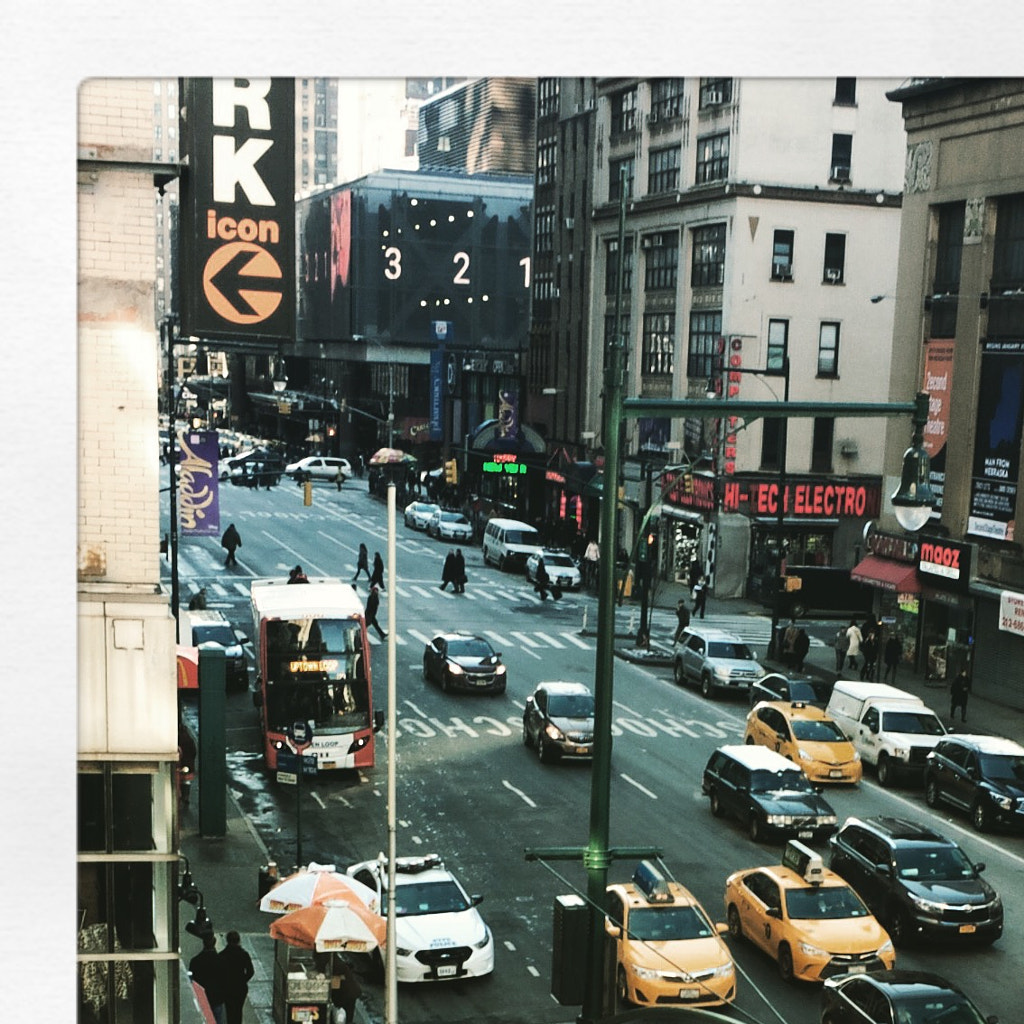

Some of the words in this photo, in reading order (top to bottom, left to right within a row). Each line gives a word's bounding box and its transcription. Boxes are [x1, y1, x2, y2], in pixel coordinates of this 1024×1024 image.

[207, 209, 280, 243] icon
[384, 246, 402, 280] 3
[453, 251, 470, 285] 2
[519, 256, 531, 288] 1
[724, 338, 742, 475] COMPTERS
[984, 467, 1008, 478] NEBRASKA
[996, 459, 1010, 469] FROM
[723, 482, 789, 513] HI-TEC
[921, 542, 960, 568] maoz
[290, 660, 320, 673] UPTOWN
